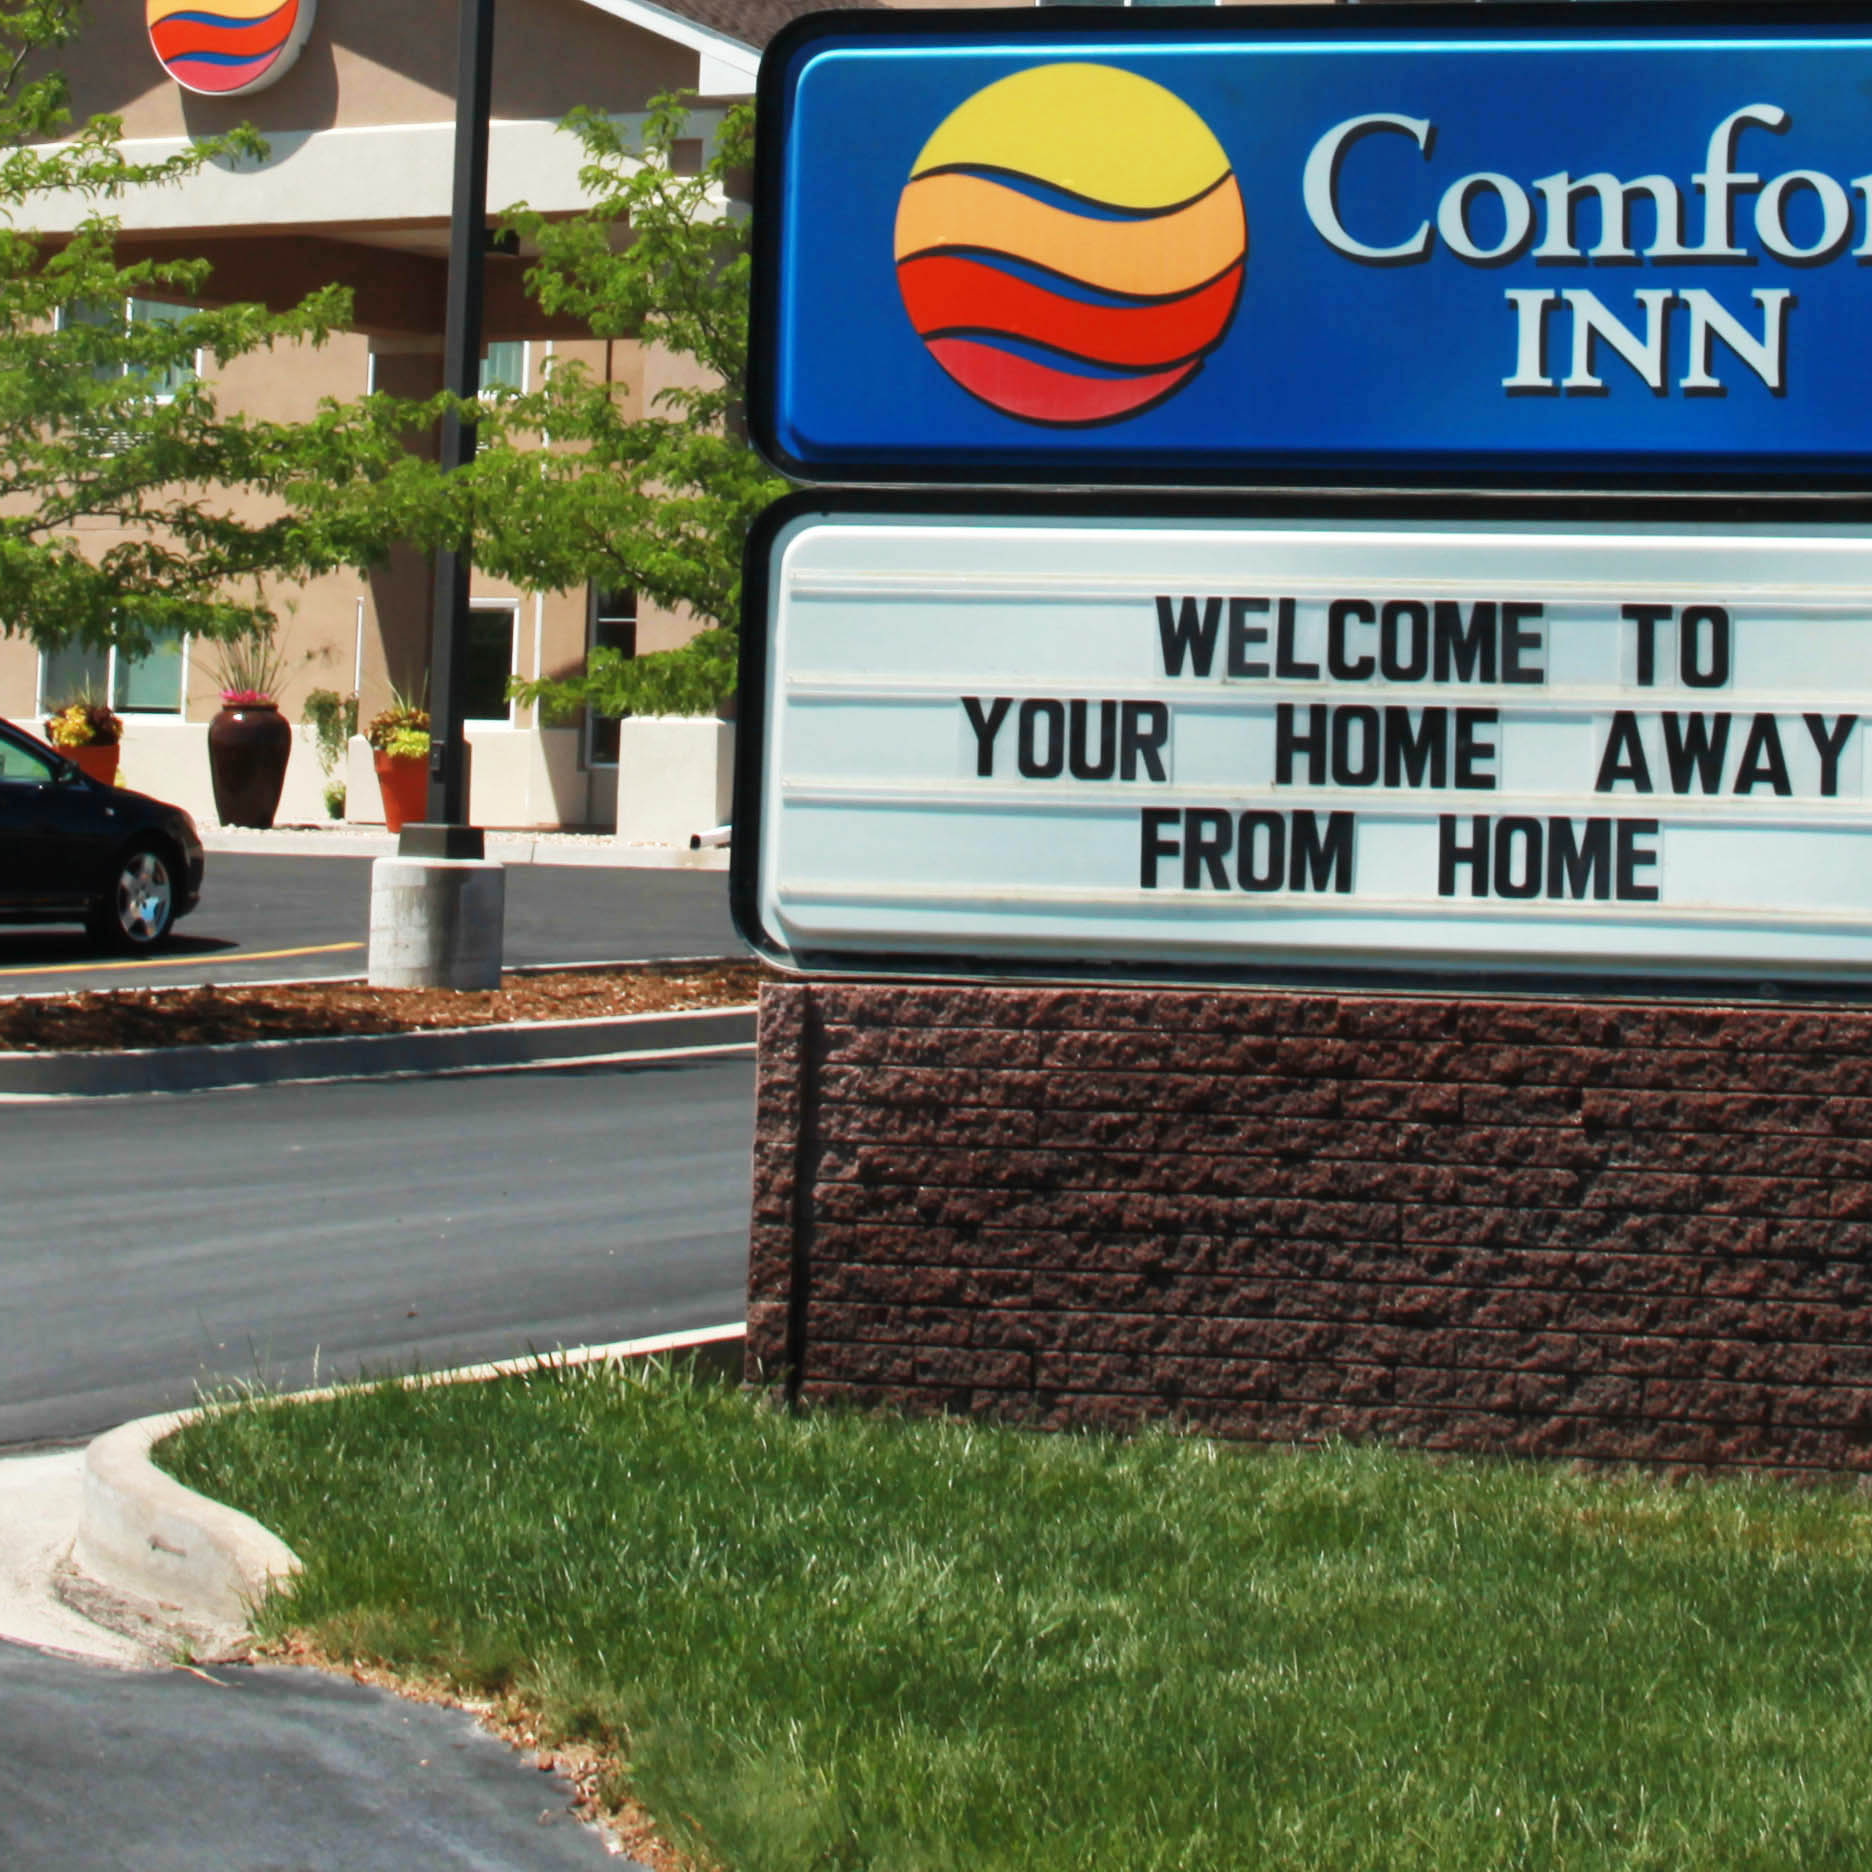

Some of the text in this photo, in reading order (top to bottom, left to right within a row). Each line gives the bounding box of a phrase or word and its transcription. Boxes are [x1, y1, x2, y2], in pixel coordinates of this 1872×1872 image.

[1503, 289, 1790, 388] INN
[1156, 597, 1729, 688] WELCOME TO
[962, 697, 1858, 795] YOUR HOME AWAY
[1141, 808, 1658, 900] FROM HOME
